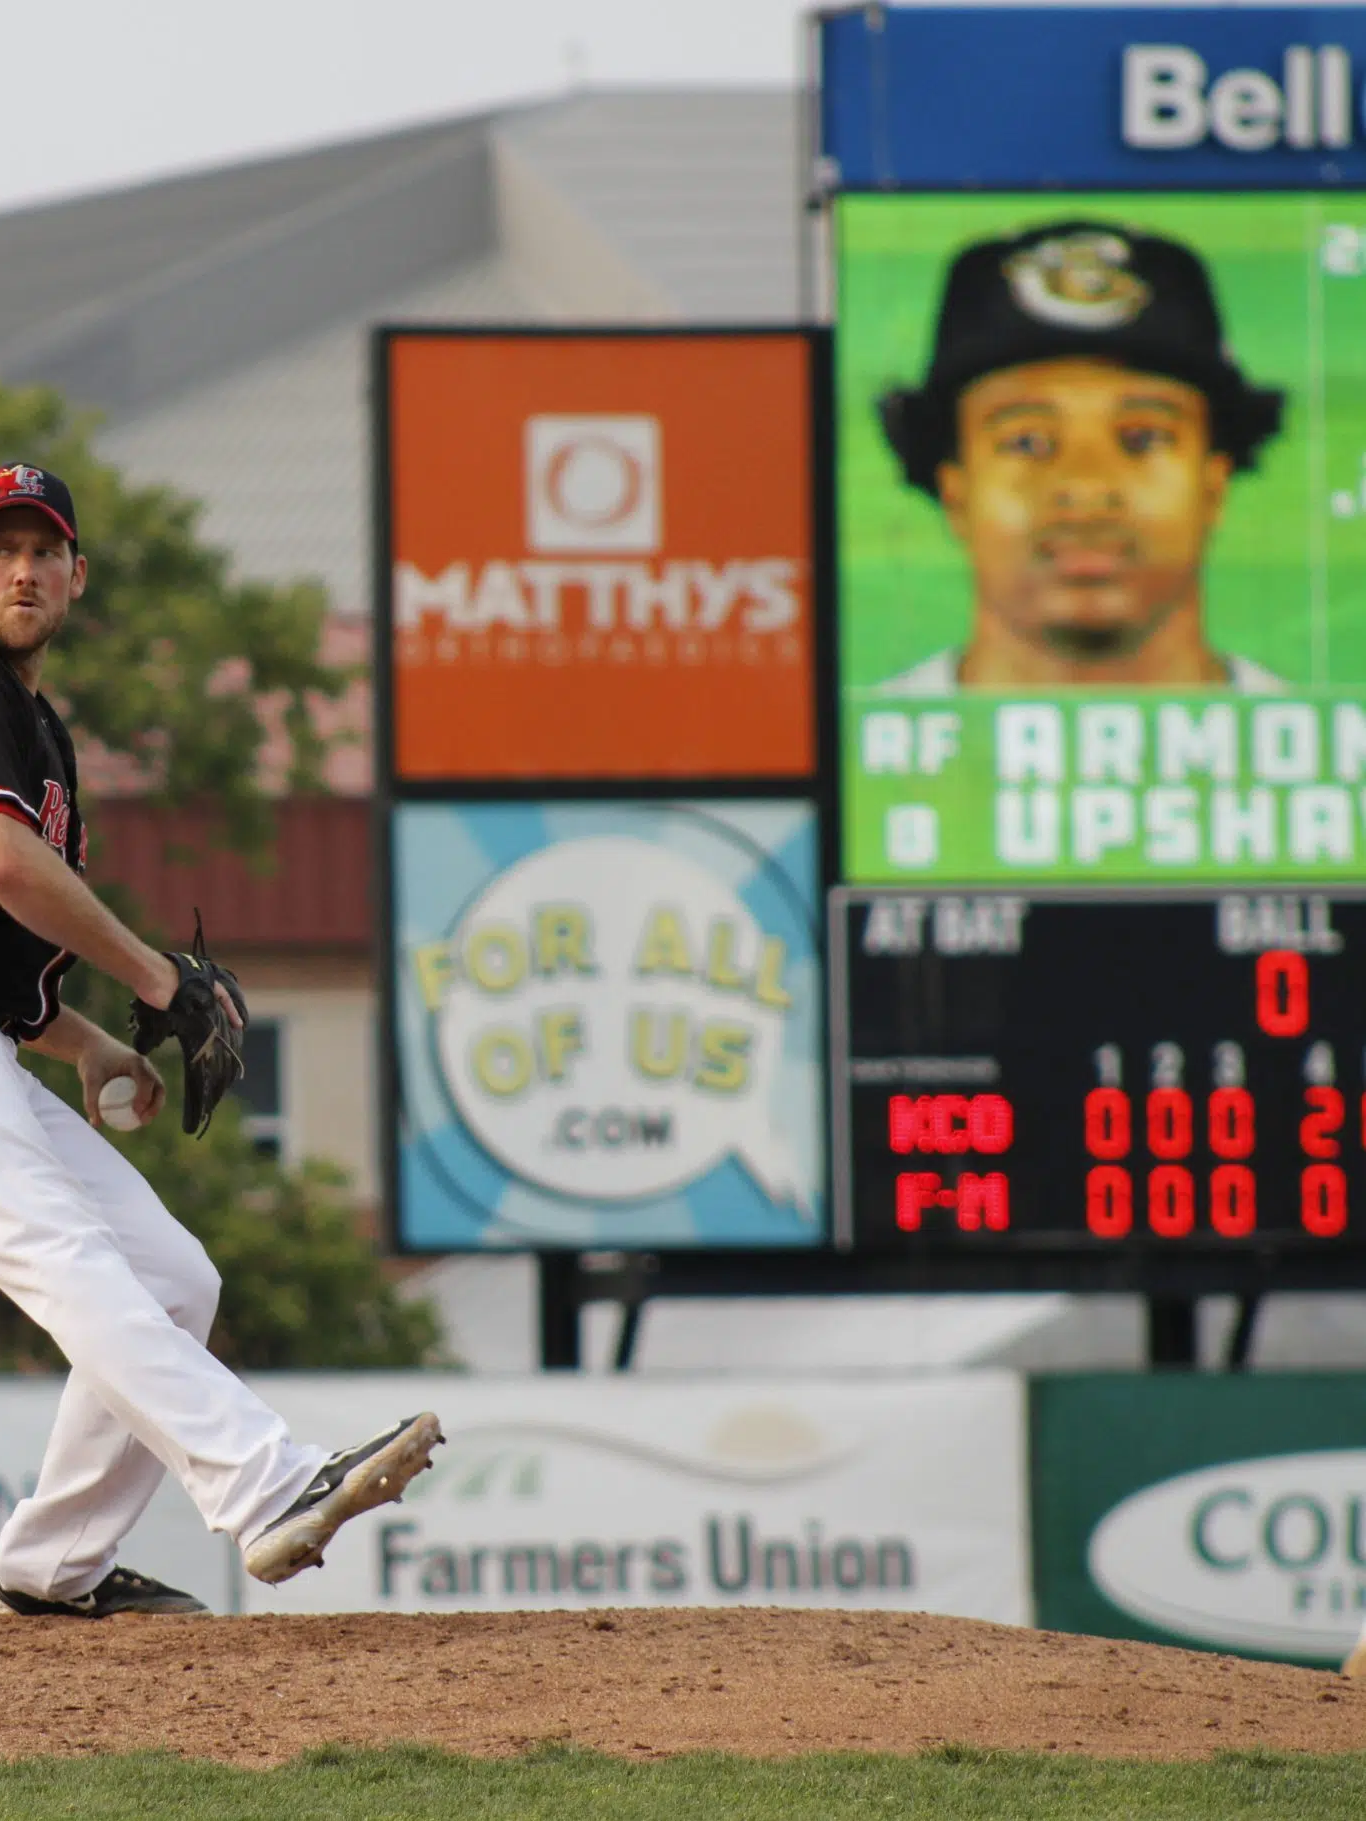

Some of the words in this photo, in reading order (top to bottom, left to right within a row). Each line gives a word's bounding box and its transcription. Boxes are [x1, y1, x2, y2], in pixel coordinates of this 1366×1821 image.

[1122, 43, 1351, 150] Bell
[395, 557, 802, 635] MATTHYS
[995, 785, 1366, 866] UPSHA
[414, 907, 596, 1013] FOR
[637, 909, 792, 1009] ALL
[863, 898, 925, 954] AT
[934, 896, 1028, 954] BAT
[1256, 949, 1309, 1037] 0
[472, 1012, 584, 1097] OF
[634, 1010, 750, 1091] US
[1095, 1044, 1122, 1087] 1
[1152, 1041, 1183, 1087] 2
[1213, 1041, 1245, 1087] 3
[1303, 1041, 1334, 1086] 4
[1084, 1087, 1132, 1160] 0
[1146, 1087, 1193, 1160] 0
[1208, 1087, 1255, 1160] 0
[1299, 1086, 1345, 1158] 2
[896, 1171, 1010, 1232] F-M
[1086, 1165, 1133, 1238] 0
[1148, 1165, 1195, 1238] 0
[1210, 1164, 1256, 1238] 0
[1301, 1164, 1348, 1237] 0
[377, 1521, 684, 1597] Farmers
[706, 1512, 916, 1593] Union
